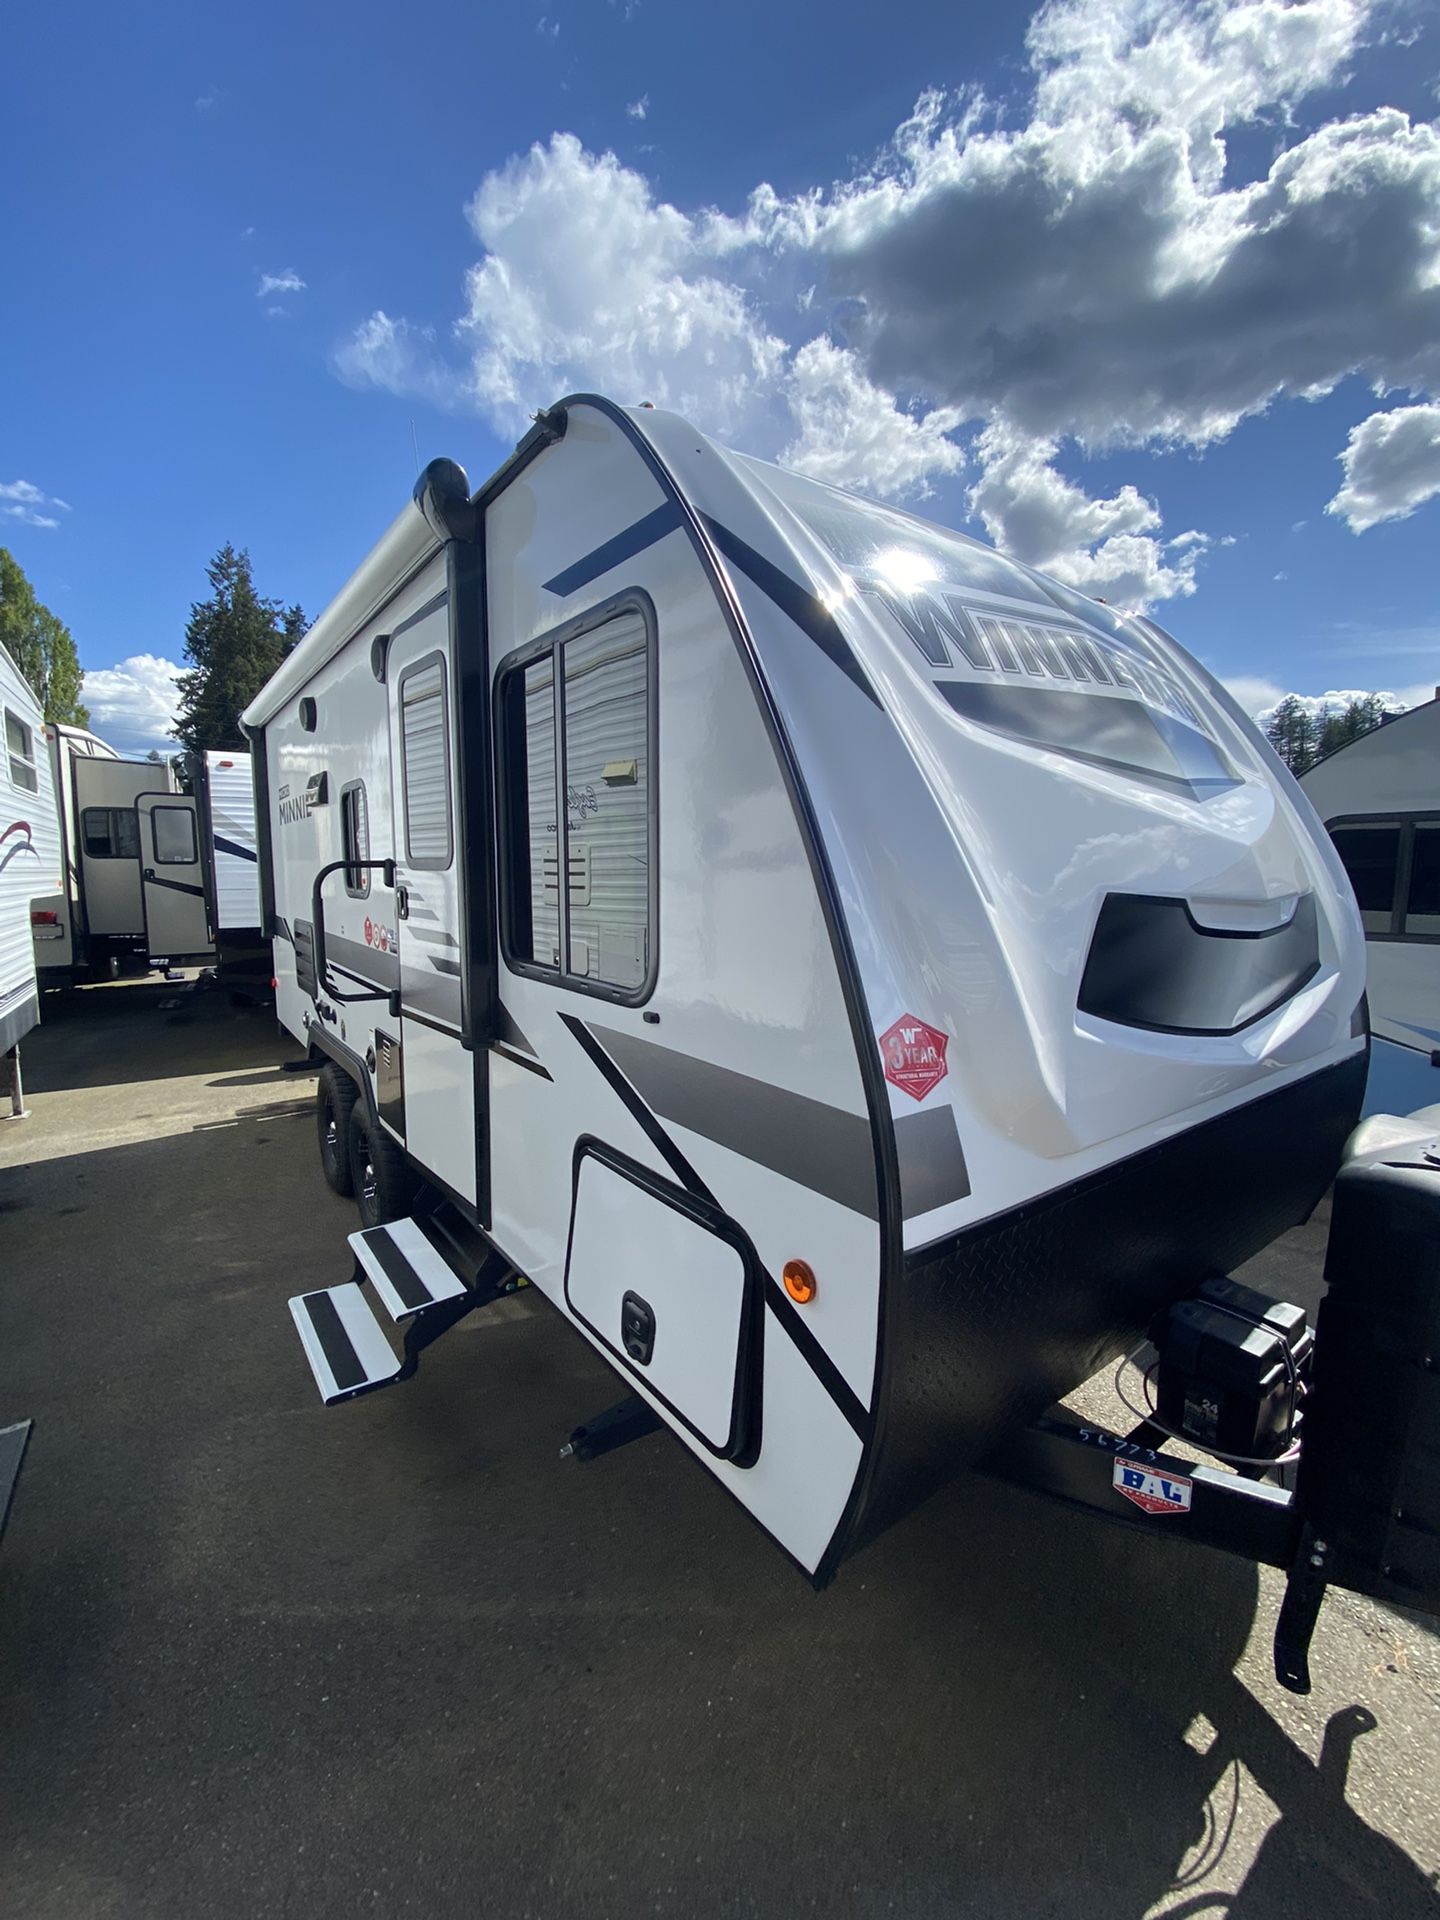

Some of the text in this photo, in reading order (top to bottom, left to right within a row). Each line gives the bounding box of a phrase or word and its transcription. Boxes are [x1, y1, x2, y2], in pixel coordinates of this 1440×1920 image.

[888, 1036, 938, 1069] 3 YEAR
[1122, 1468, 1182, 1503] BAL
